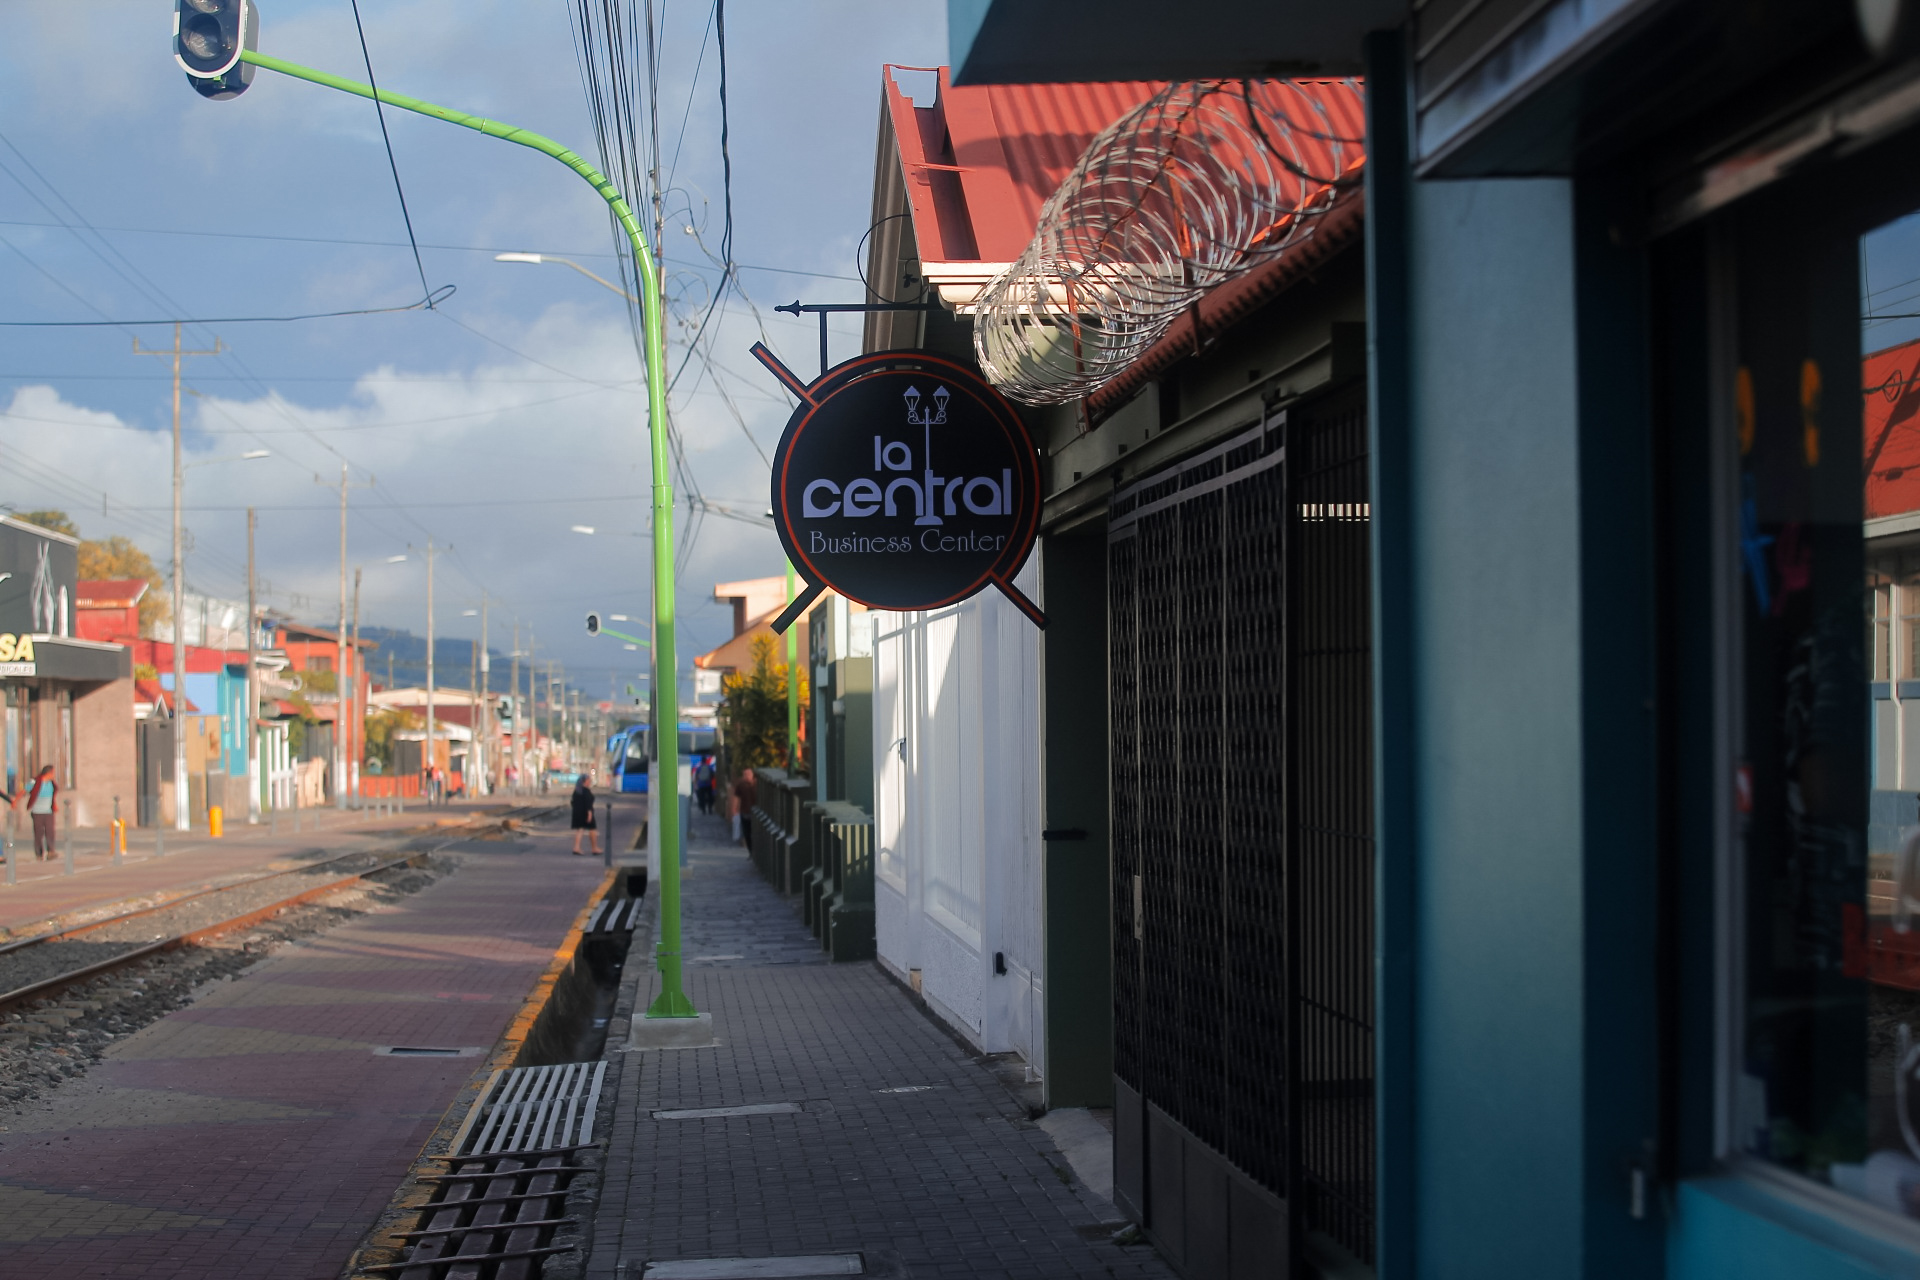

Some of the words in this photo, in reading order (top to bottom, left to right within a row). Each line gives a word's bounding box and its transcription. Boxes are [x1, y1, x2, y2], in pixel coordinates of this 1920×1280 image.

[874, 435, 912, 471] la
[802, 468, 1012, 525] central
[809, 530, 912, 554] Business
[920, 528, 1006, 552] Center
